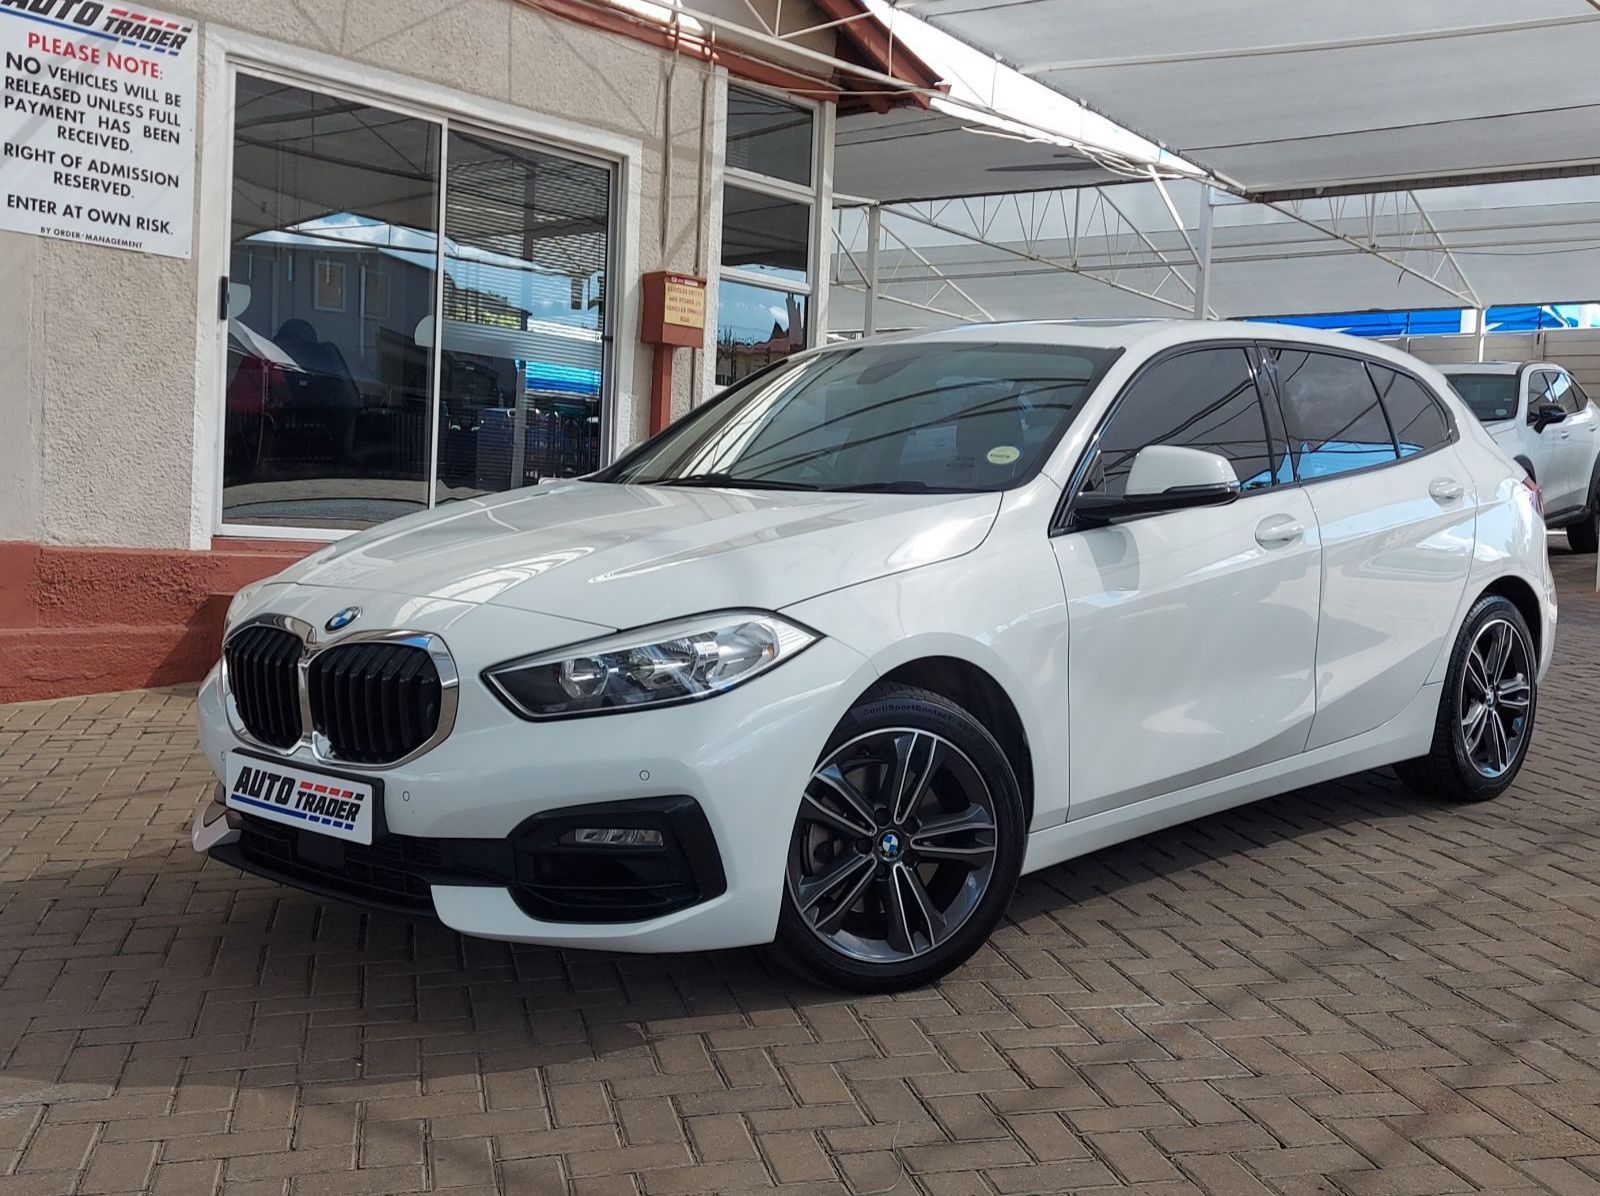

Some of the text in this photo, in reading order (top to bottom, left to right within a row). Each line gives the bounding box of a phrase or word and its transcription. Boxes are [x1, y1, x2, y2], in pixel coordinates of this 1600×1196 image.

[28, 32, 163, 80] PLEASE NOTE:
[103, 16, 187, 50] TRADER
[5, 76, 181, 127] RELEASED UNLESS FULL
[6, 51, 181, 107] NO VEHICLES WILL BE
[4, 95, 180, 145] PAYMENT HAS BEEN
[57, 126, 133, 153] RECEIVED.
[3, 142, 179, 188] RIGHT OF ADMISSION
[54, 171, 135, 199] RESERVED.
[7, 194, 174, 235] ENTER AT OWN RISK.
[40, 226, 51, 234] BY
[85, 233, 143, 249] MANAGEMENT
[233, 765, 361, 822] AUTO TRADER
